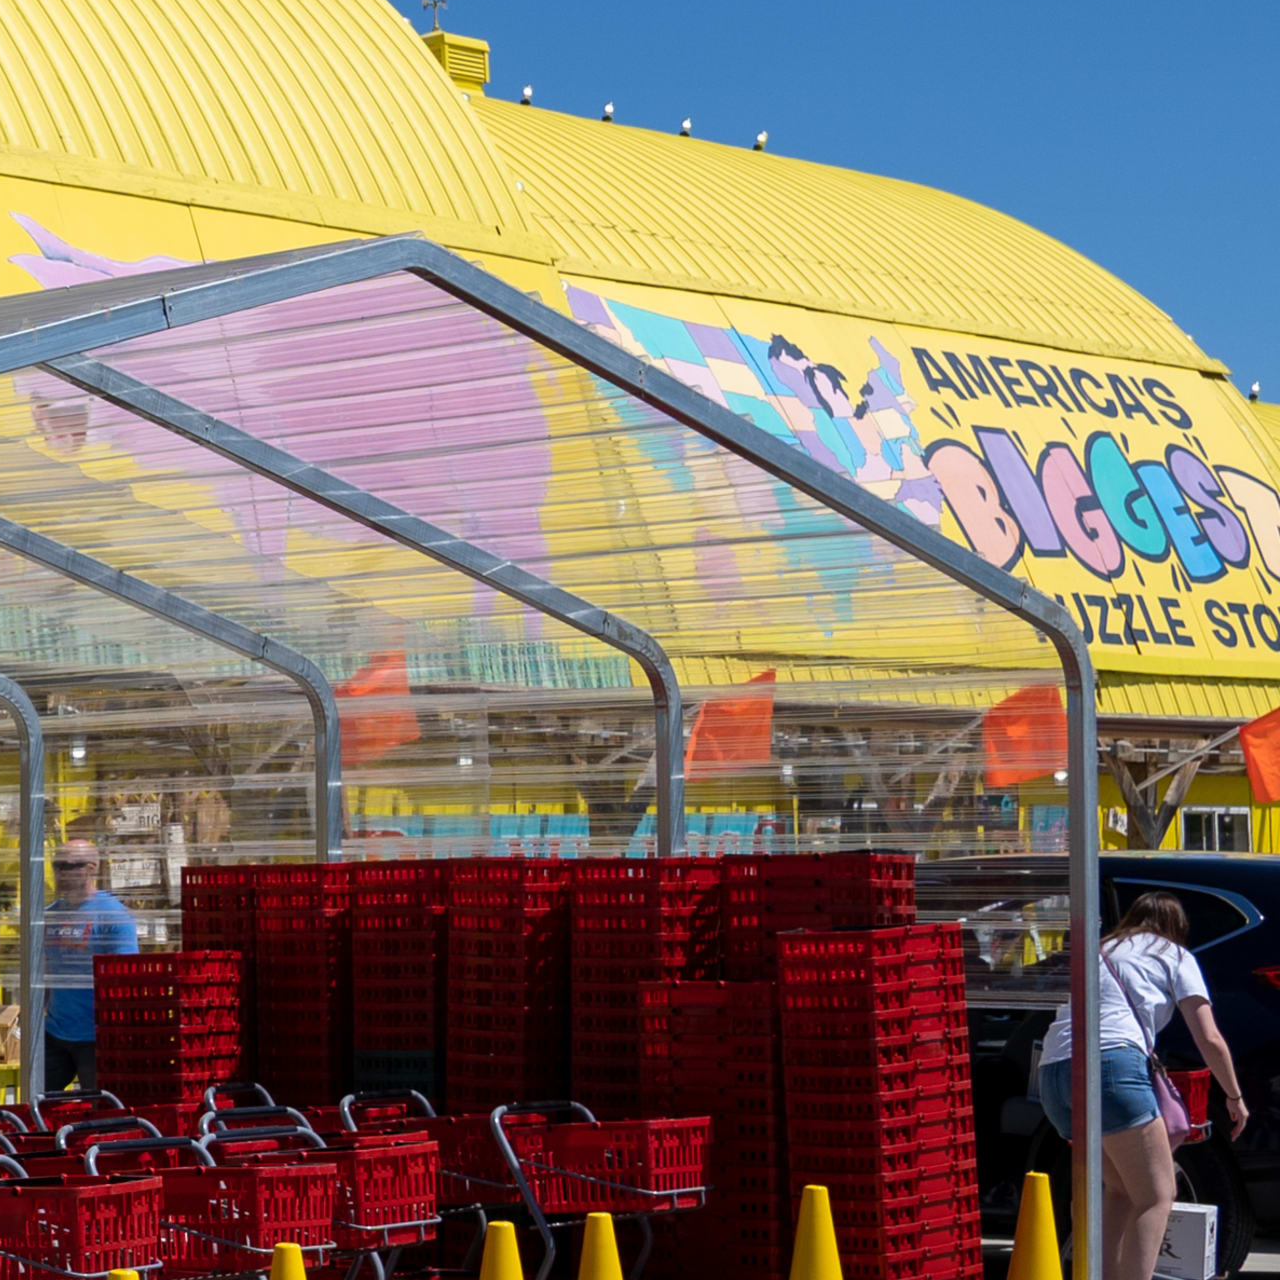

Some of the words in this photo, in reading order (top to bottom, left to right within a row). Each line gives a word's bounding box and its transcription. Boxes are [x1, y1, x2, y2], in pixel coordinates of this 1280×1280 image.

[911, 346, 1194, 432] AMERICA'S
[1039, 592, 1195, 647] UZZLE
[1204, 598, 1280, 652] STO
